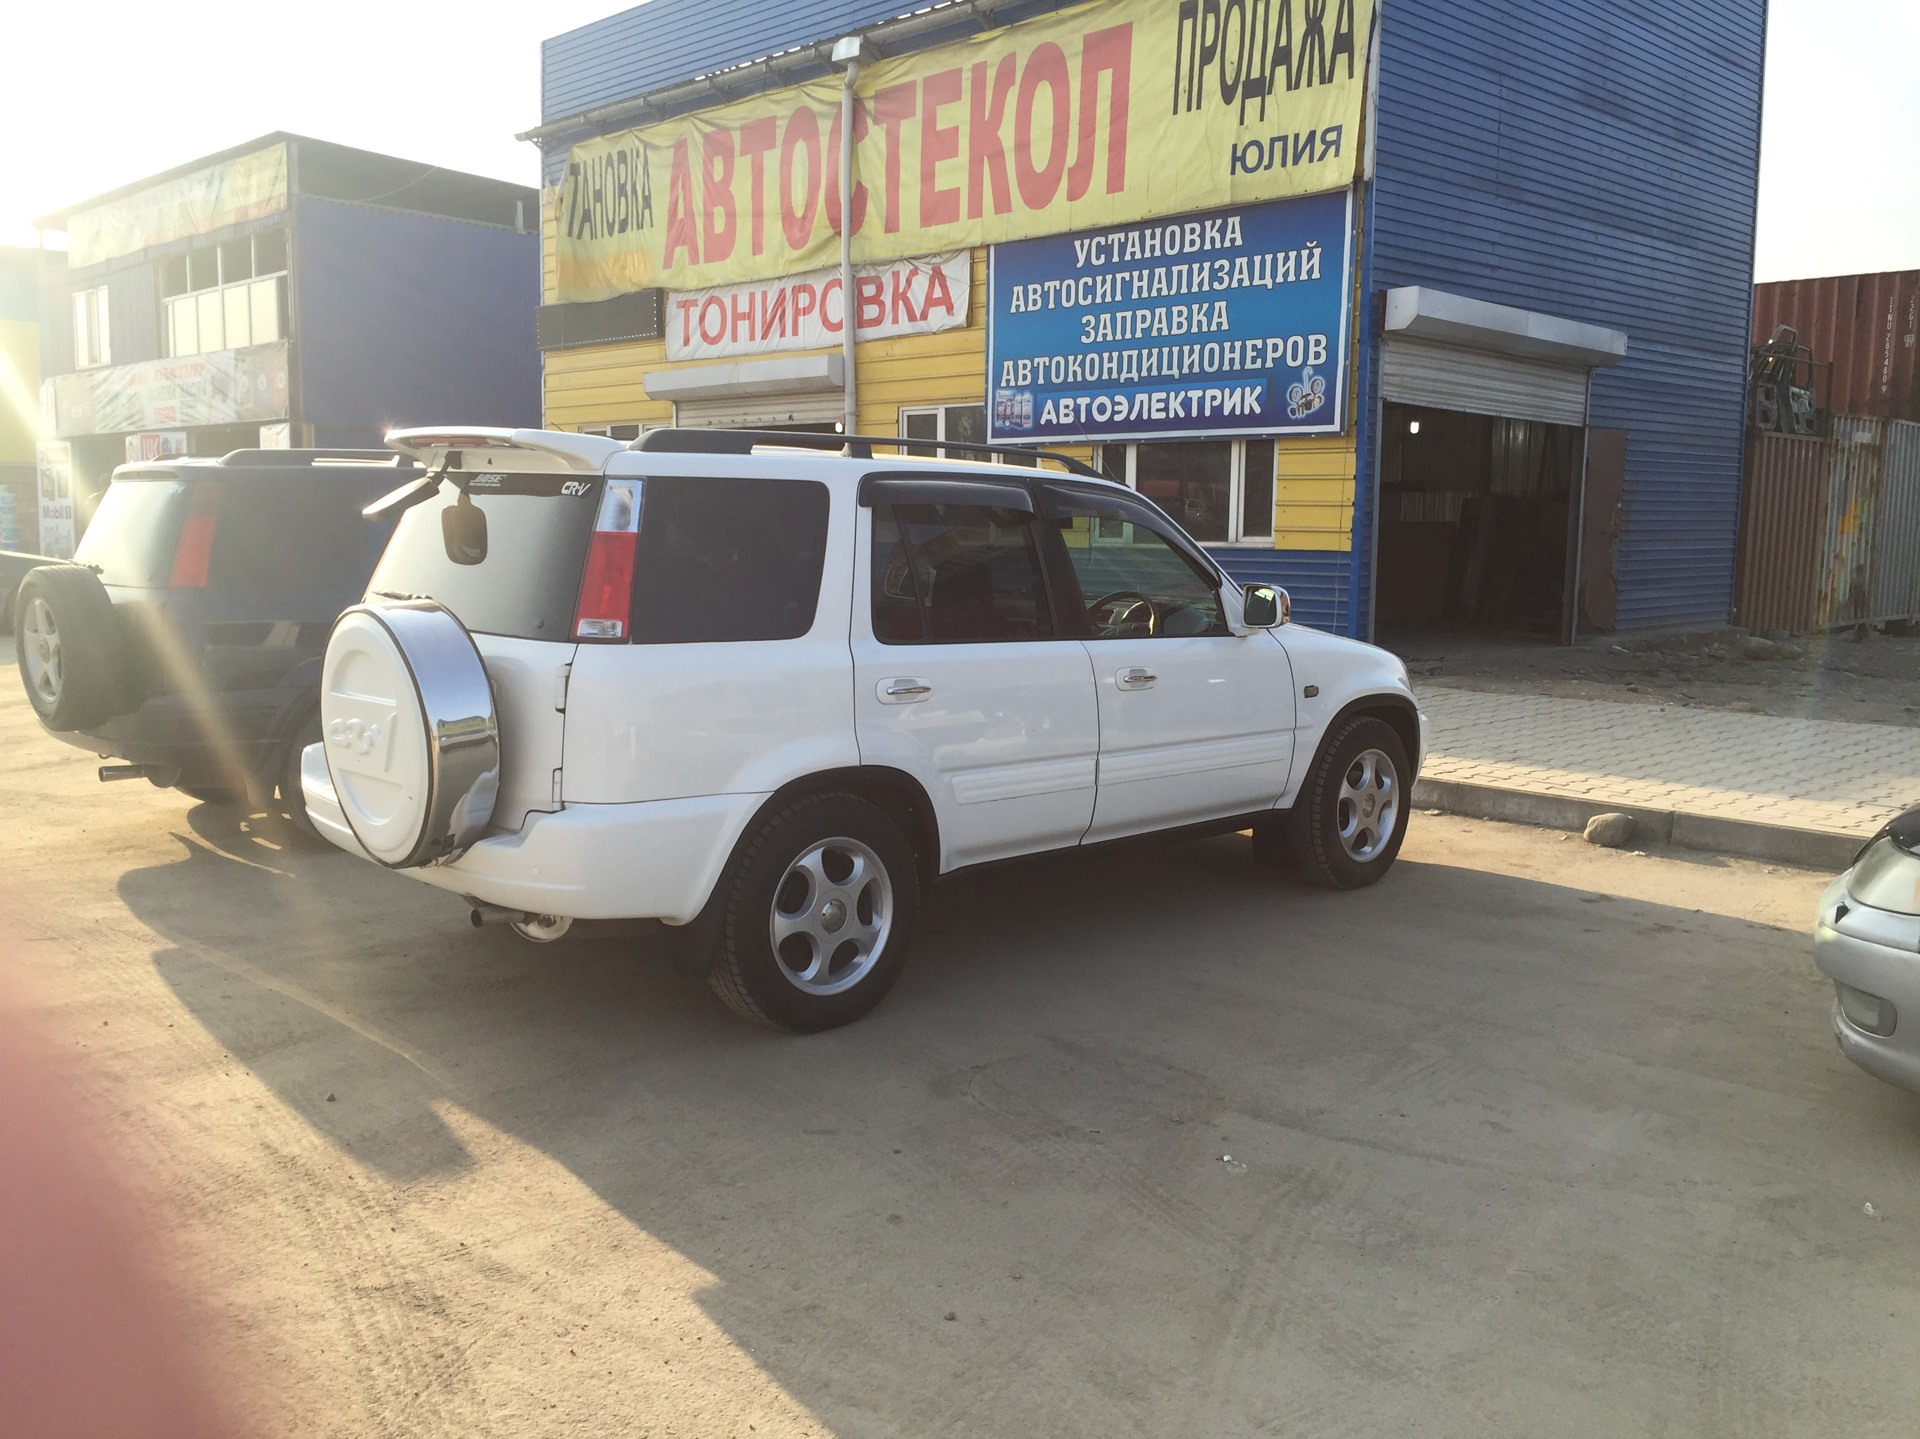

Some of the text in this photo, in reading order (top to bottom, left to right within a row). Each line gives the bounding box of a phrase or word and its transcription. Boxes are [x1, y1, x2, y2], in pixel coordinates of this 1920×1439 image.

[1173, 0, 1355, 126] ПРОДАЖА
[662, 21, 1134, 270] АВТОСТЕКОЛ
[1230, 124, 1343, 176] ЮЛИЯ
[1074, 216, 1243, 268] УСТАНОВКА
[1010, 241, 1322, 314] АВТОСИГНАЛИЗАЦИЙ
[676, 265, 955, 347] ТОНИРОВКА
[1080, 300, 1230, 344] ЗАПРАВКА
[1000, 333, 1328, 388] АВТОКОНДИЦИОНЕРОВ
[1040, 385, 1263, 426] АВТОЭЛЕКТРИК
[561, 481, 591, 495] CR-V
